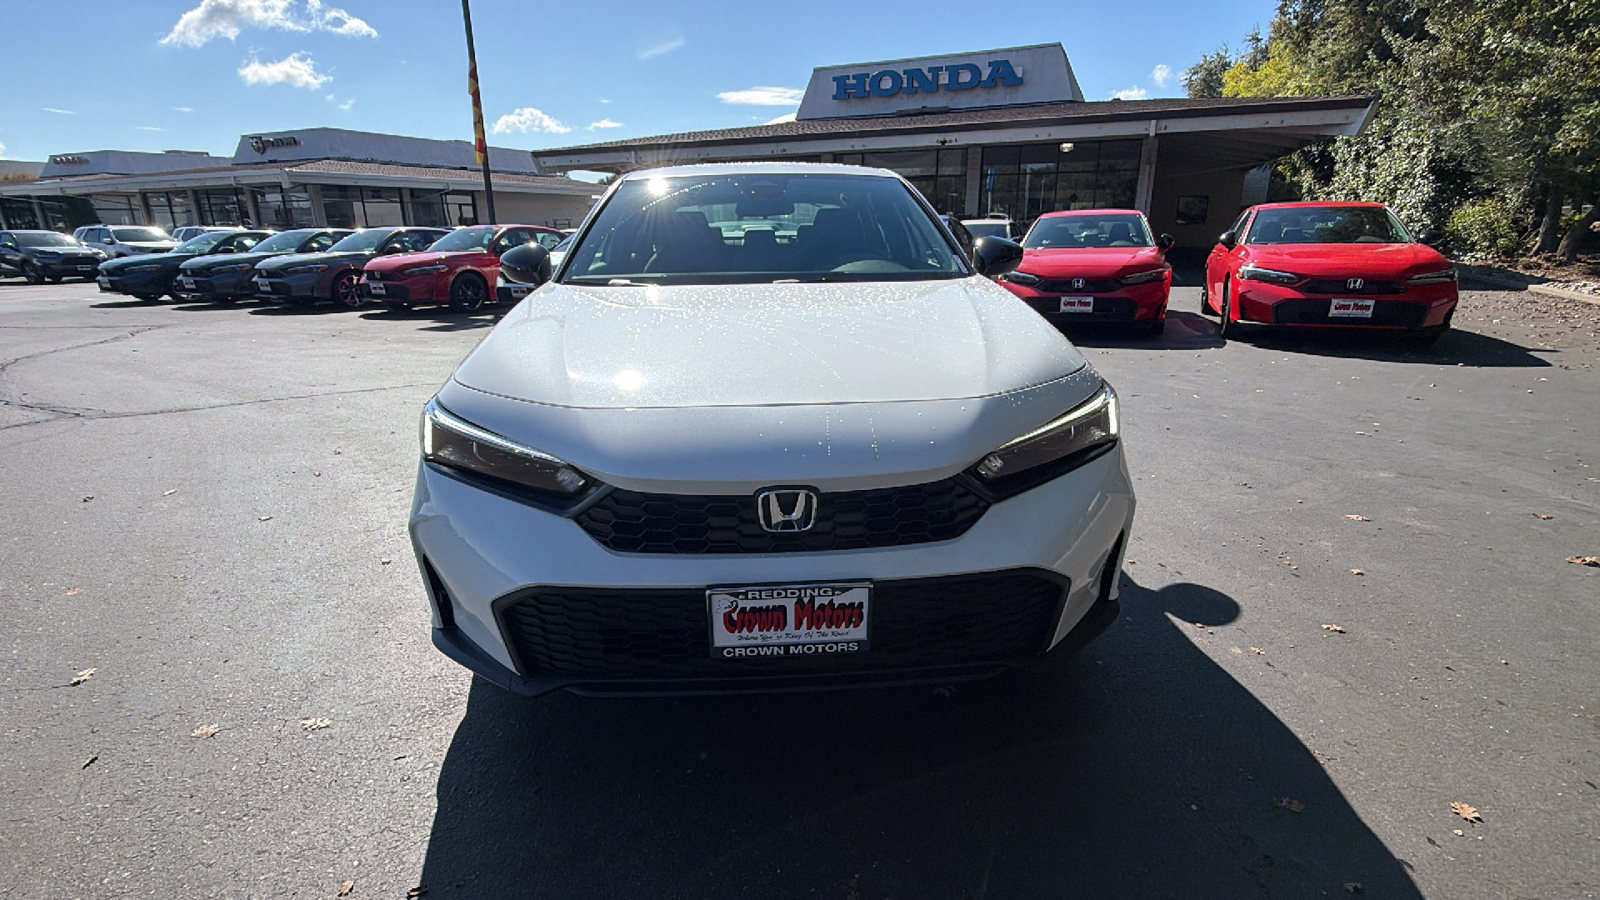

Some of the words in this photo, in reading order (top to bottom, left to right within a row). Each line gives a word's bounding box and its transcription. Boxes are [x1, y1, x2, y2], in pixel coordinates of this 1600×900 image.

[832, 59, 1024, 101] HONDA
[747, 588, 833, 600] REDDING
[723, 600, 788, 634] Crown
[794, 596, 865, 631] Motors
[737, 633, 759, 641] Where
[784, 632, 802, 640] King
[804, 631, 814, 639] Of
[831, 630, 851, 638] Road
[722, 645, 785, 658] CROWN
[789, 642, 860, 655] MOTORS
